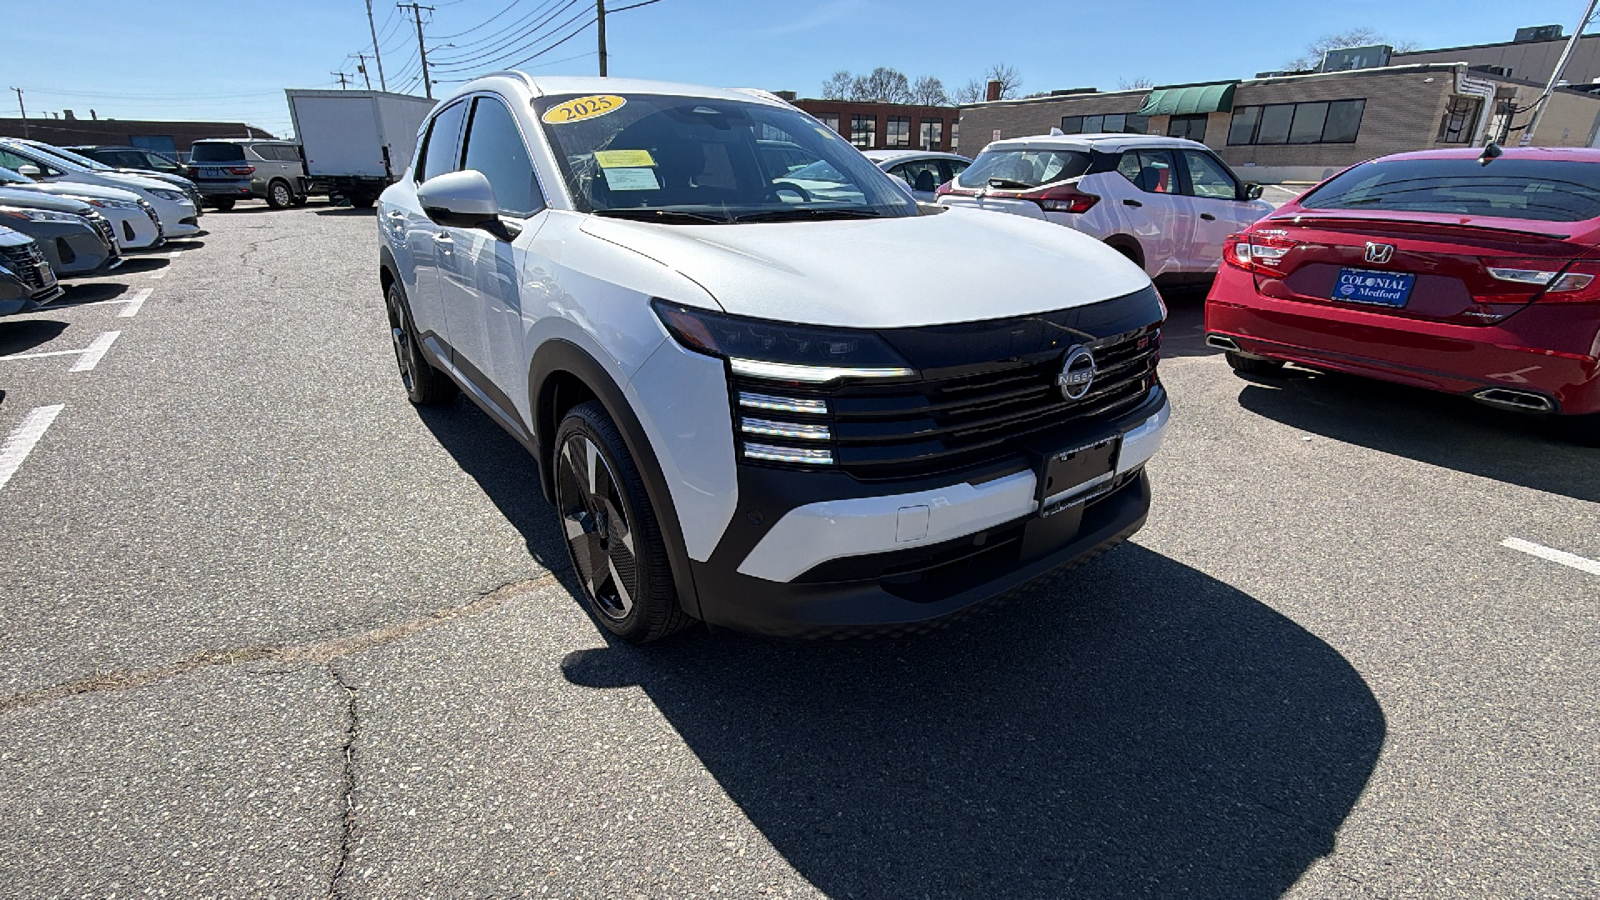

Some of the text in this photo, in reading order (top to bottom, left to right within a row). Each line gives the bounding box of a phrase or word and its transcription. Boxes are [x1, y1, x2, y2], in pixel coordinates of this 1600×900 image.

[560, 97, 612, 120] 2025
[1341, 274, 1406, 291] COLONIAL
[1358, 287, 1401, 299] Medford
[1059, 368, 1097, 384] NISSAN
